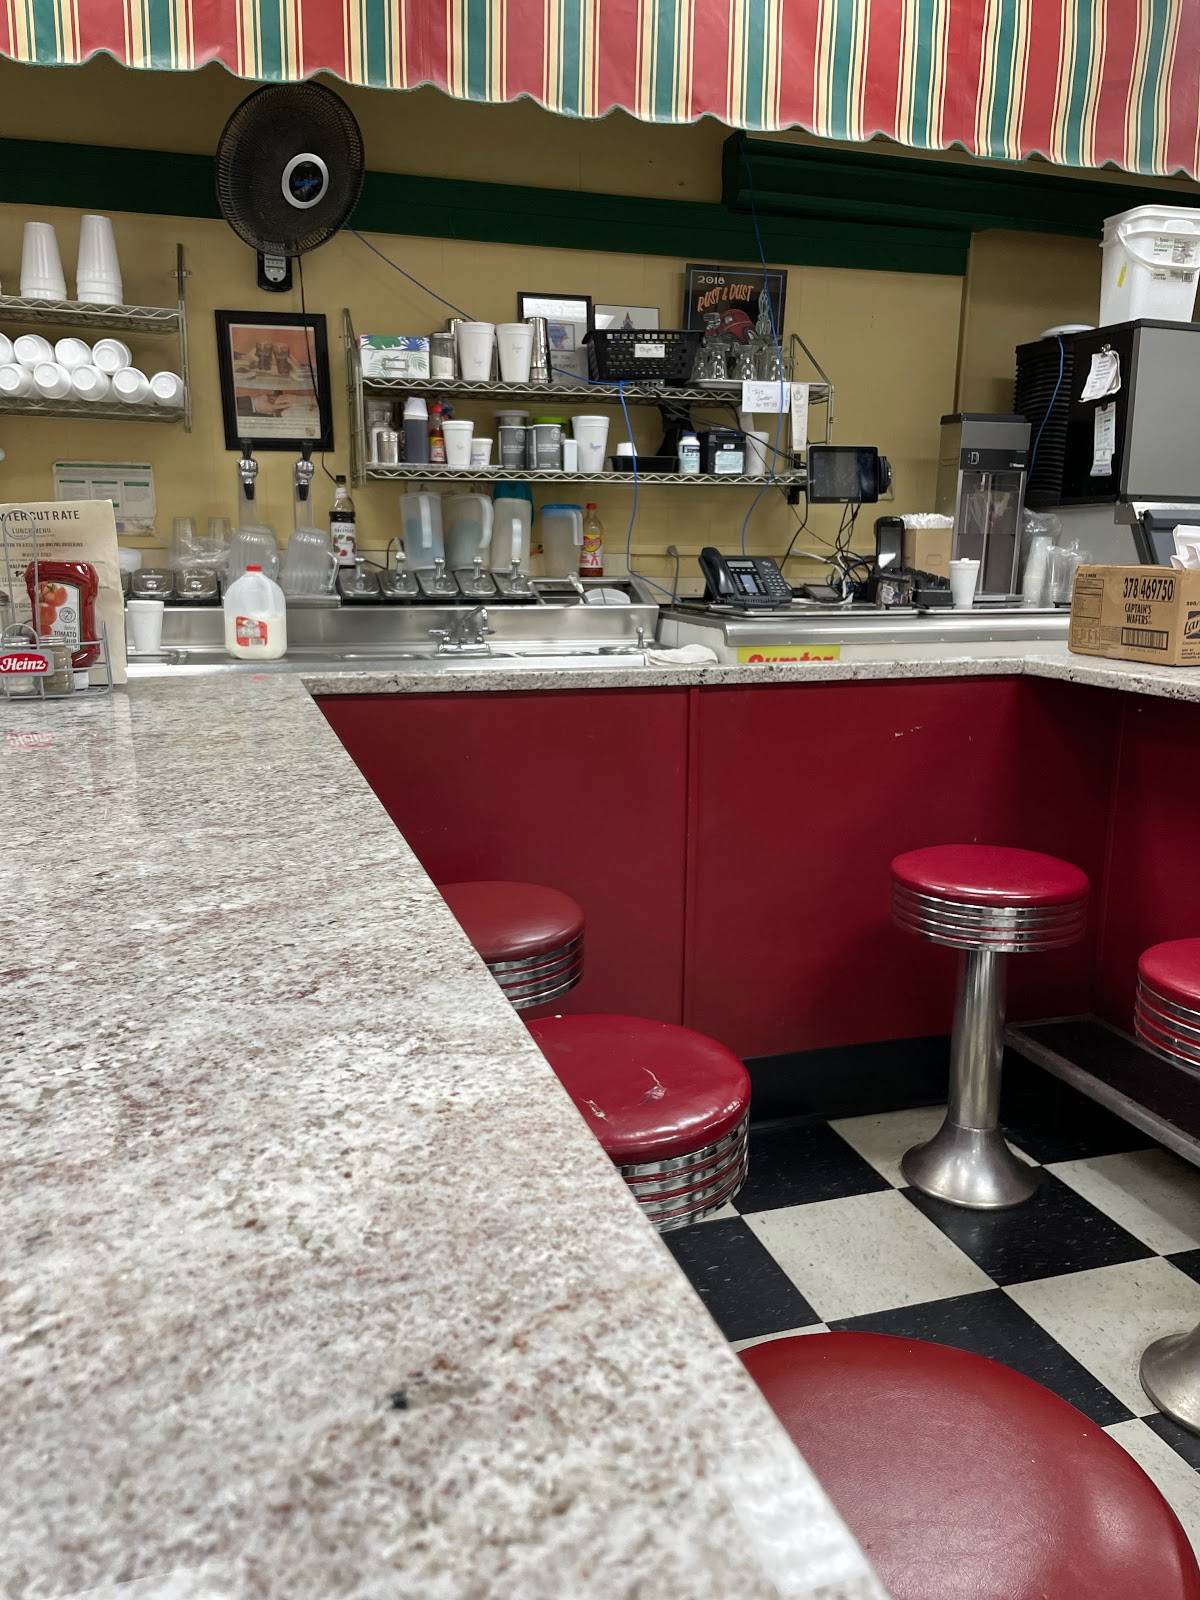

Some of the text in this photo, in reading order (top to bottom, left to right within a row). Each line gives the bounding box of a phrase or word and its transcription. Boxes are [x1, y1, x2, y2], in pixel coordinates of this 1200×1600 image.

[697, 275, 725, 285] 2018
[697, 286, 722, 312] RUST
[729, 283, 755, 302] DUST
[52, 510, 80, 521] RATE
[1123, 577, 1174, 601] 378 469750
[1124, 603, 1152, 615] CAPTAIN'S
[54, 630, 77, 638] TOMATO
[0, 657, 46, 672] Heinz
